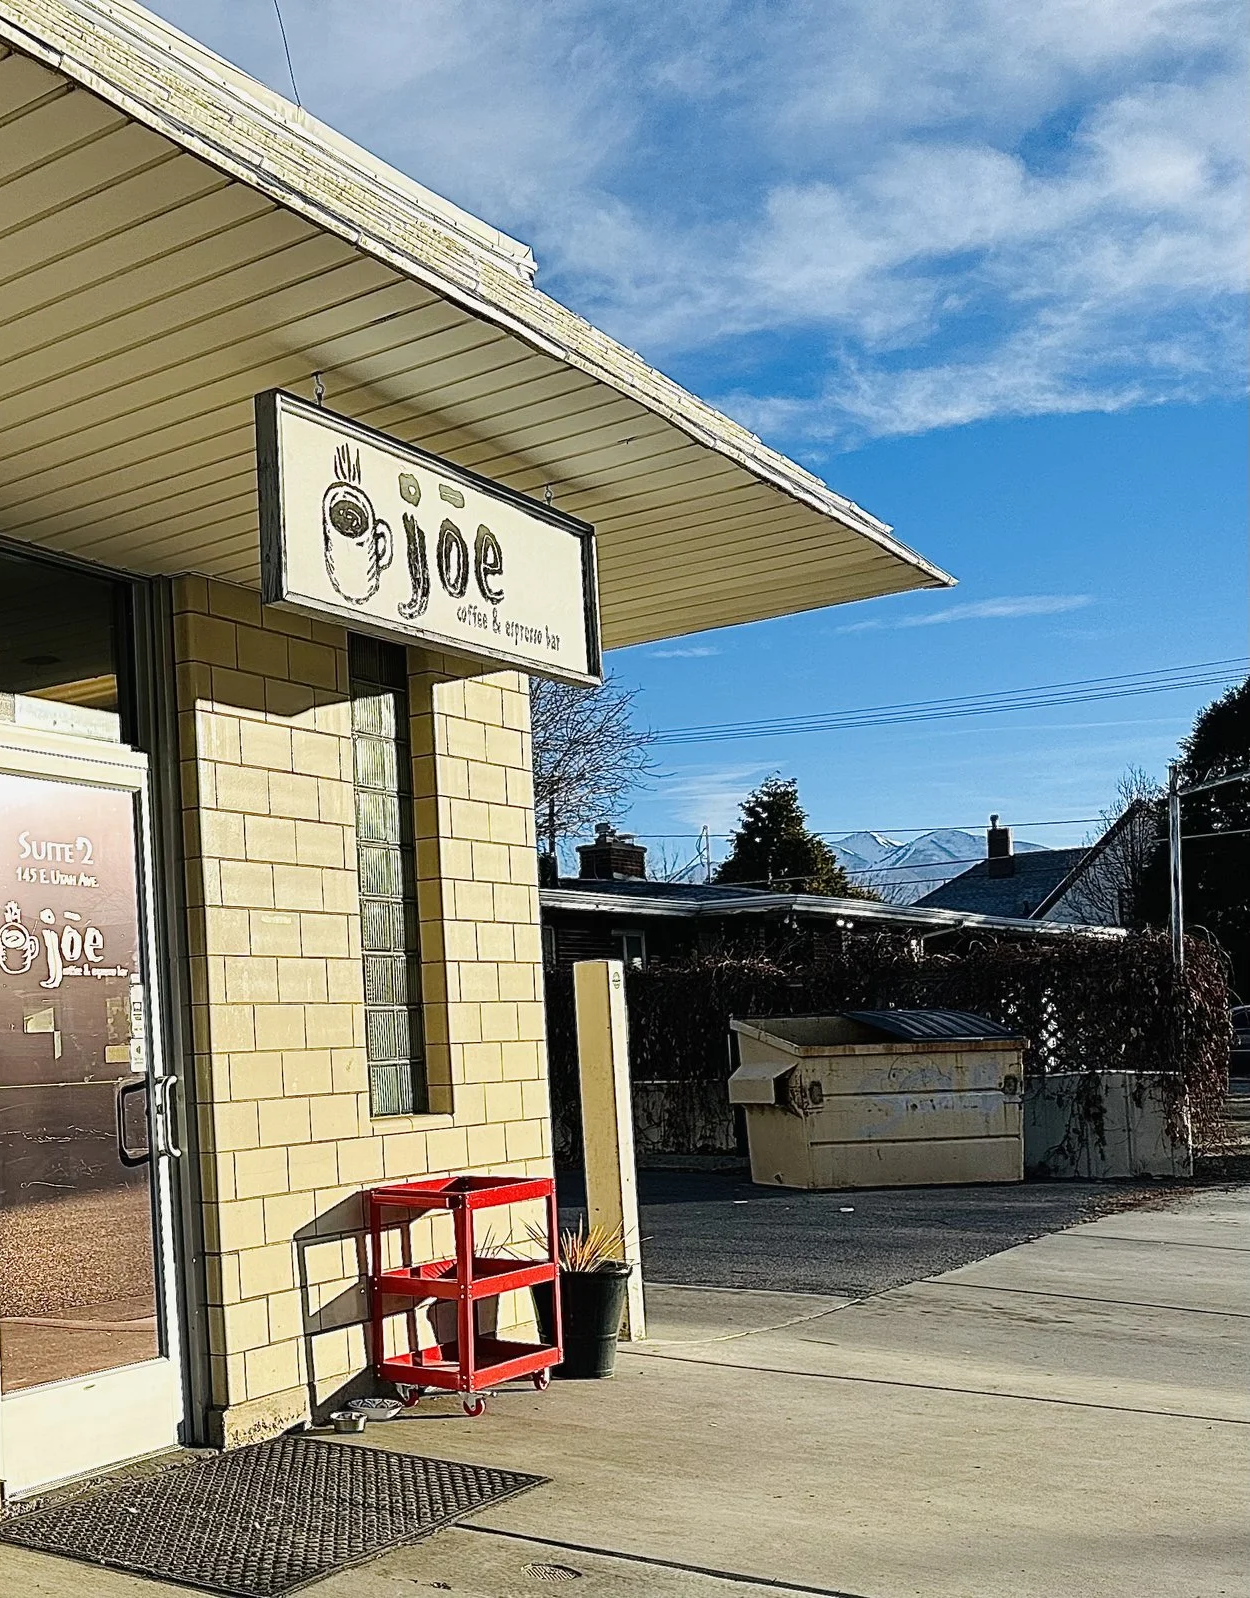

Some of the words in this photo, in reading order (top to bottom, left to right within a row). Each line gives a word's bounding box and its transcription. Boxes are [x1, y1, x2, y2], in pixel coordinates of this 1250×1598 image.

[456, 604, 488, 630] coffee
[492, 607, 502, 634] &
[505, 620, 543, 646] espresso
[545, 624, 561, 651] bar
[75, 836, 94, 865] 2
[15, 866, 38, 883] 145
